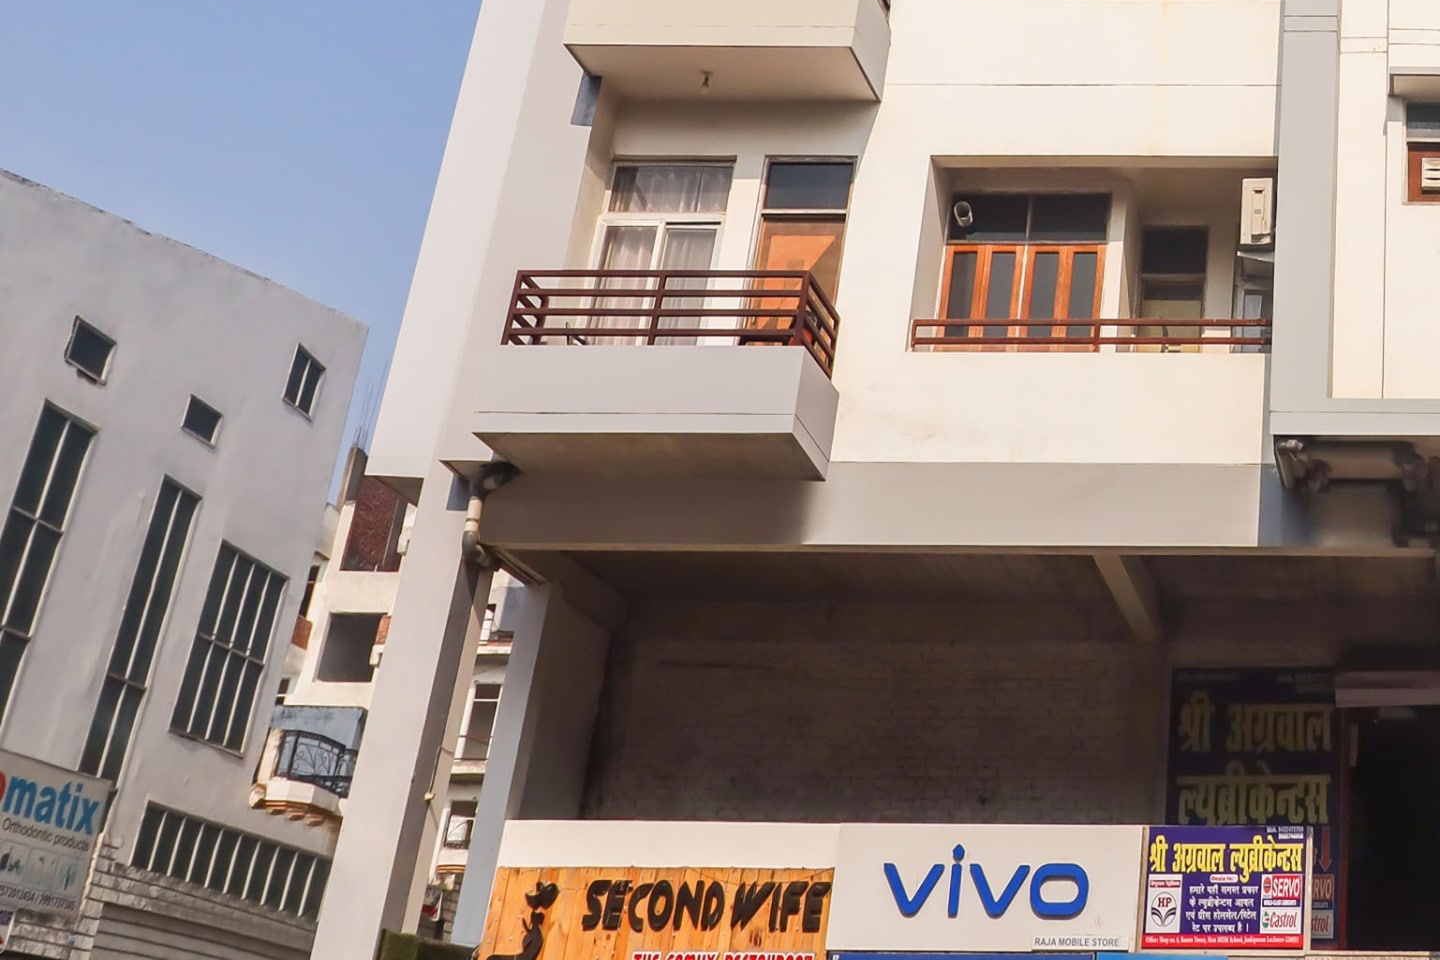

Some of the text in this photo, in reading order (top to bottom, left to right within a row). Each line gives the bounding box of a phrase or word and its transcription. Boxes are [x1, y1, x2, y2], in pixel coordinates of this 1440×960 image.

[1149, 835, 1168, 873] श्री
[1172, 843, 1226, 873] अग्रवाल
[883, 844, 1090, 920] vivo
[1272, 878, 1300, 897] SERVO
[1312, 879, 1332, 898] RVO
[582, 880, 832, 933] SECOND WIFE
[1158, 898, 1172, 907] HP
[1270, 912, 1297, 928] Castrol
[1311, 915, 1329, 932] strol
[1034, 937, 1120, 947] RAJA MOBILE STORE
